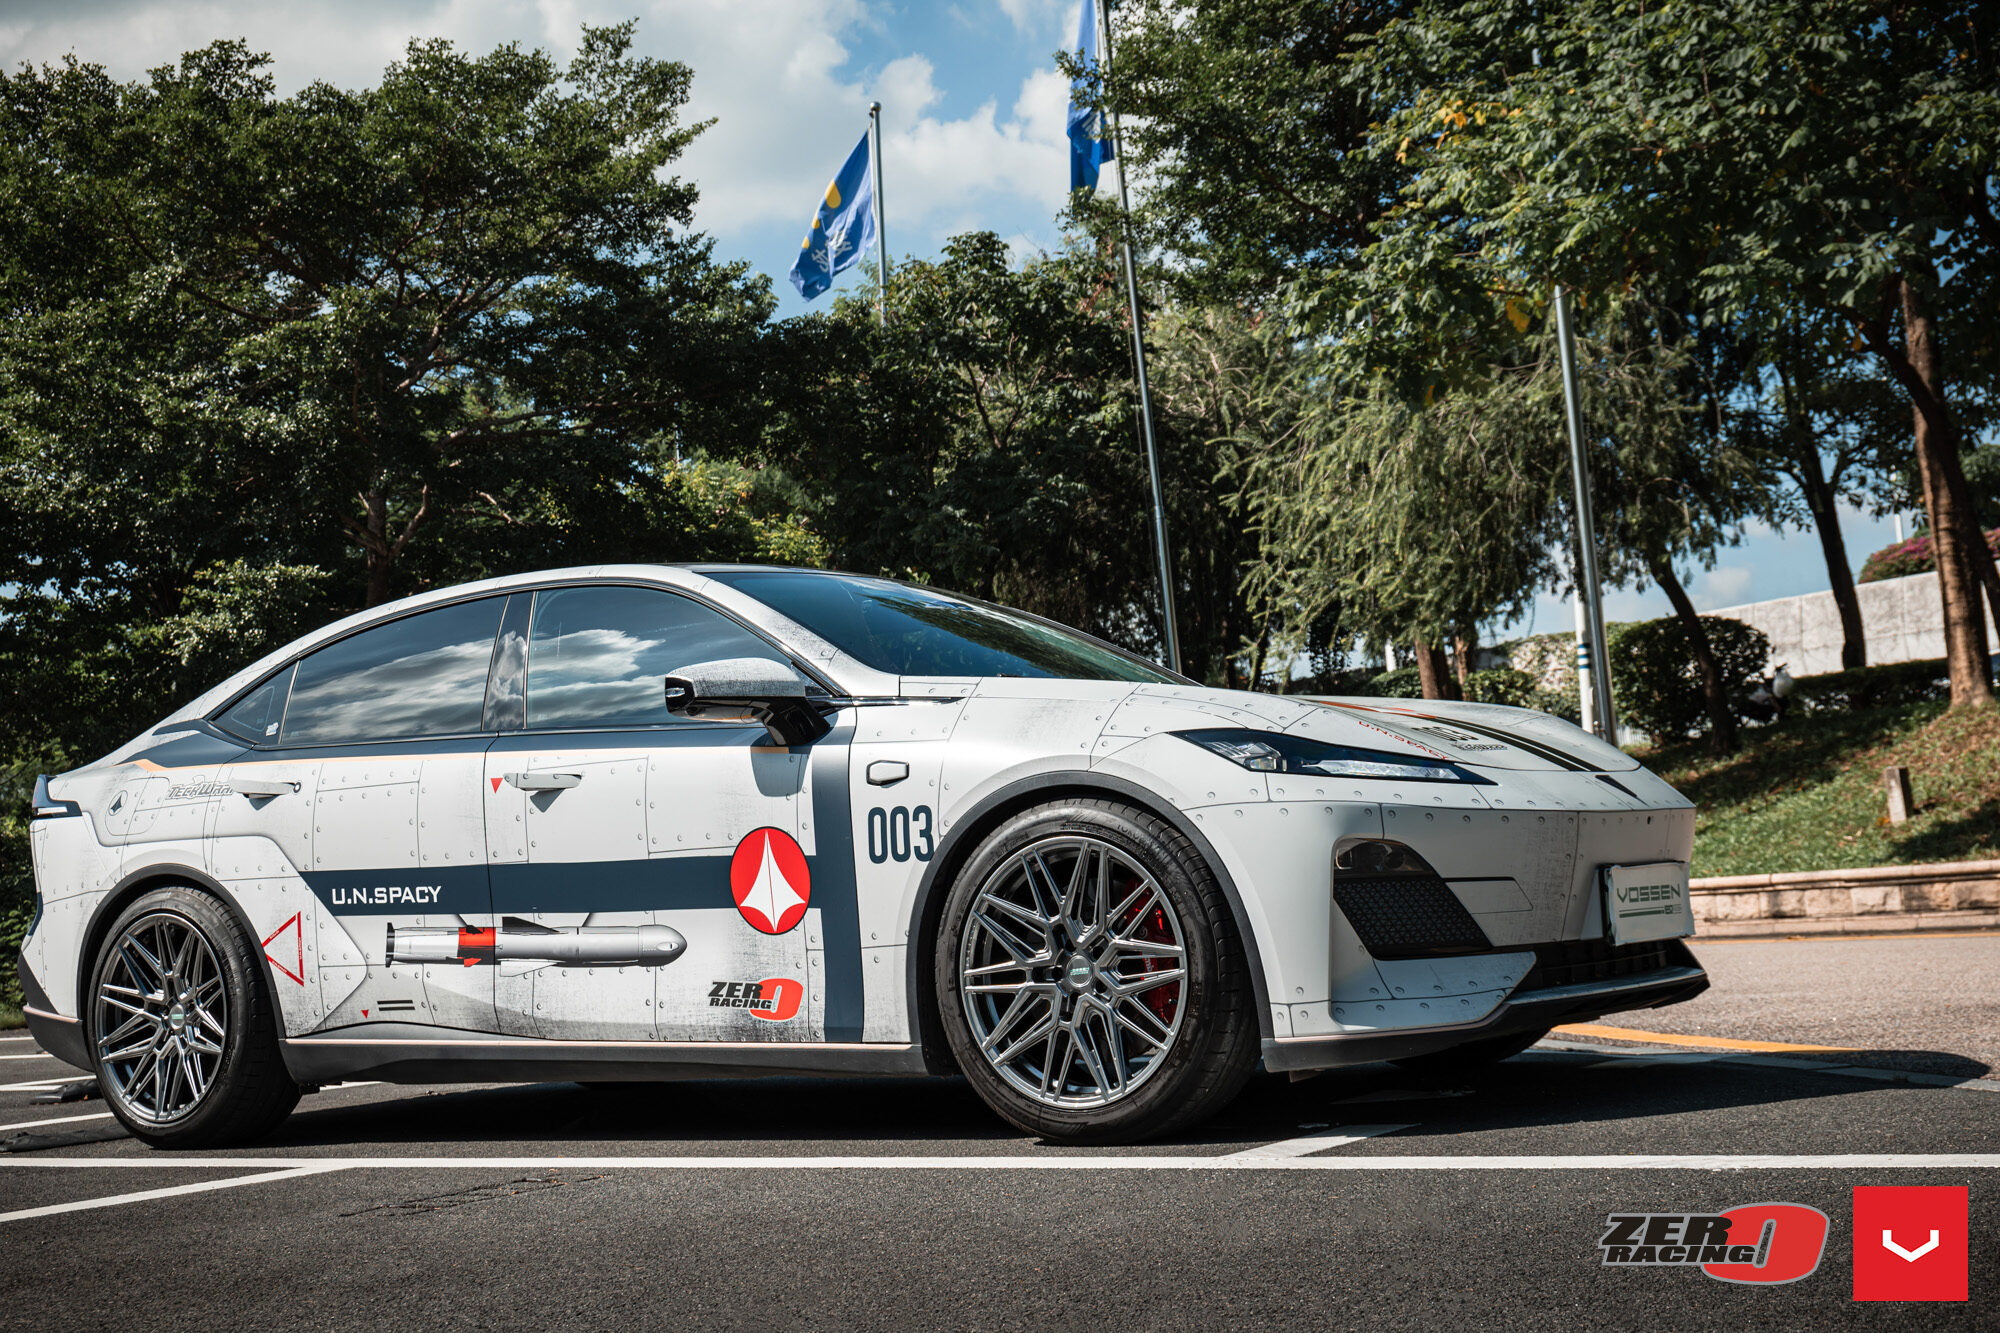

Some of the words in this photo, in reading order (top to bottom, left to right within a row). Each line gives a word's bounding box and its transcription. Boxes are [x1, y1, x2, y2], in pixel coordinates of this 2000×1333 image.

[867, 804, 935, 865] 003
[331, 885, 442, 905] U.N.SPACY
[1616, 883, 1681, 903] VOSSEN
[709, 997, 772, 1010] RACING
